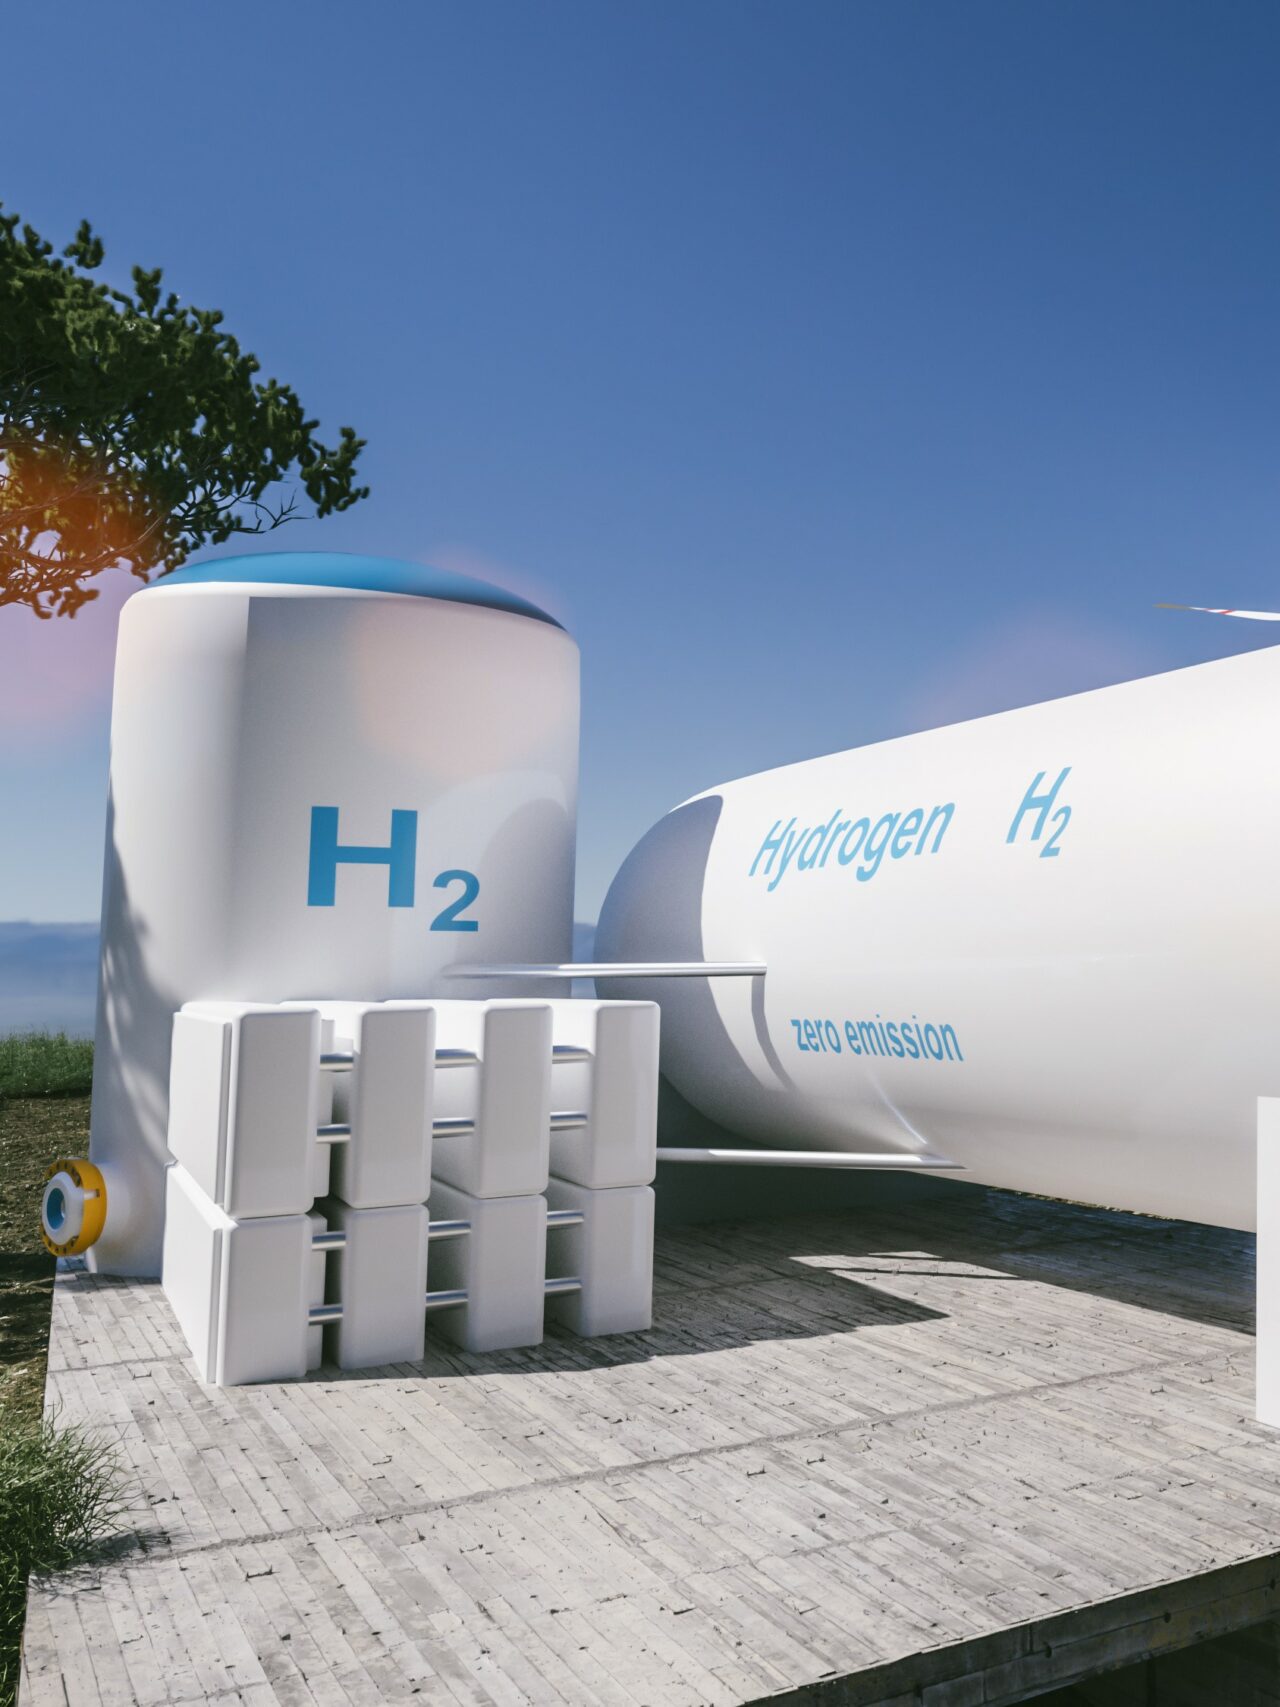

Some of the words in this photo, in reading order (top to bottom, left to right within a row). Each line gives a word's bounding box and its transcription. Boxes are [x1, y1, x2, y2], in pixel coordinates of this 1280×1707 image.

[307, 805, 481, 932] H2
[748, 802, 956, 892] Hydrogen
[1006, 767, 1073, 859] H2
[791, 1017, 842, 1054] zero
[844, 1013, 964, 1062] emission
